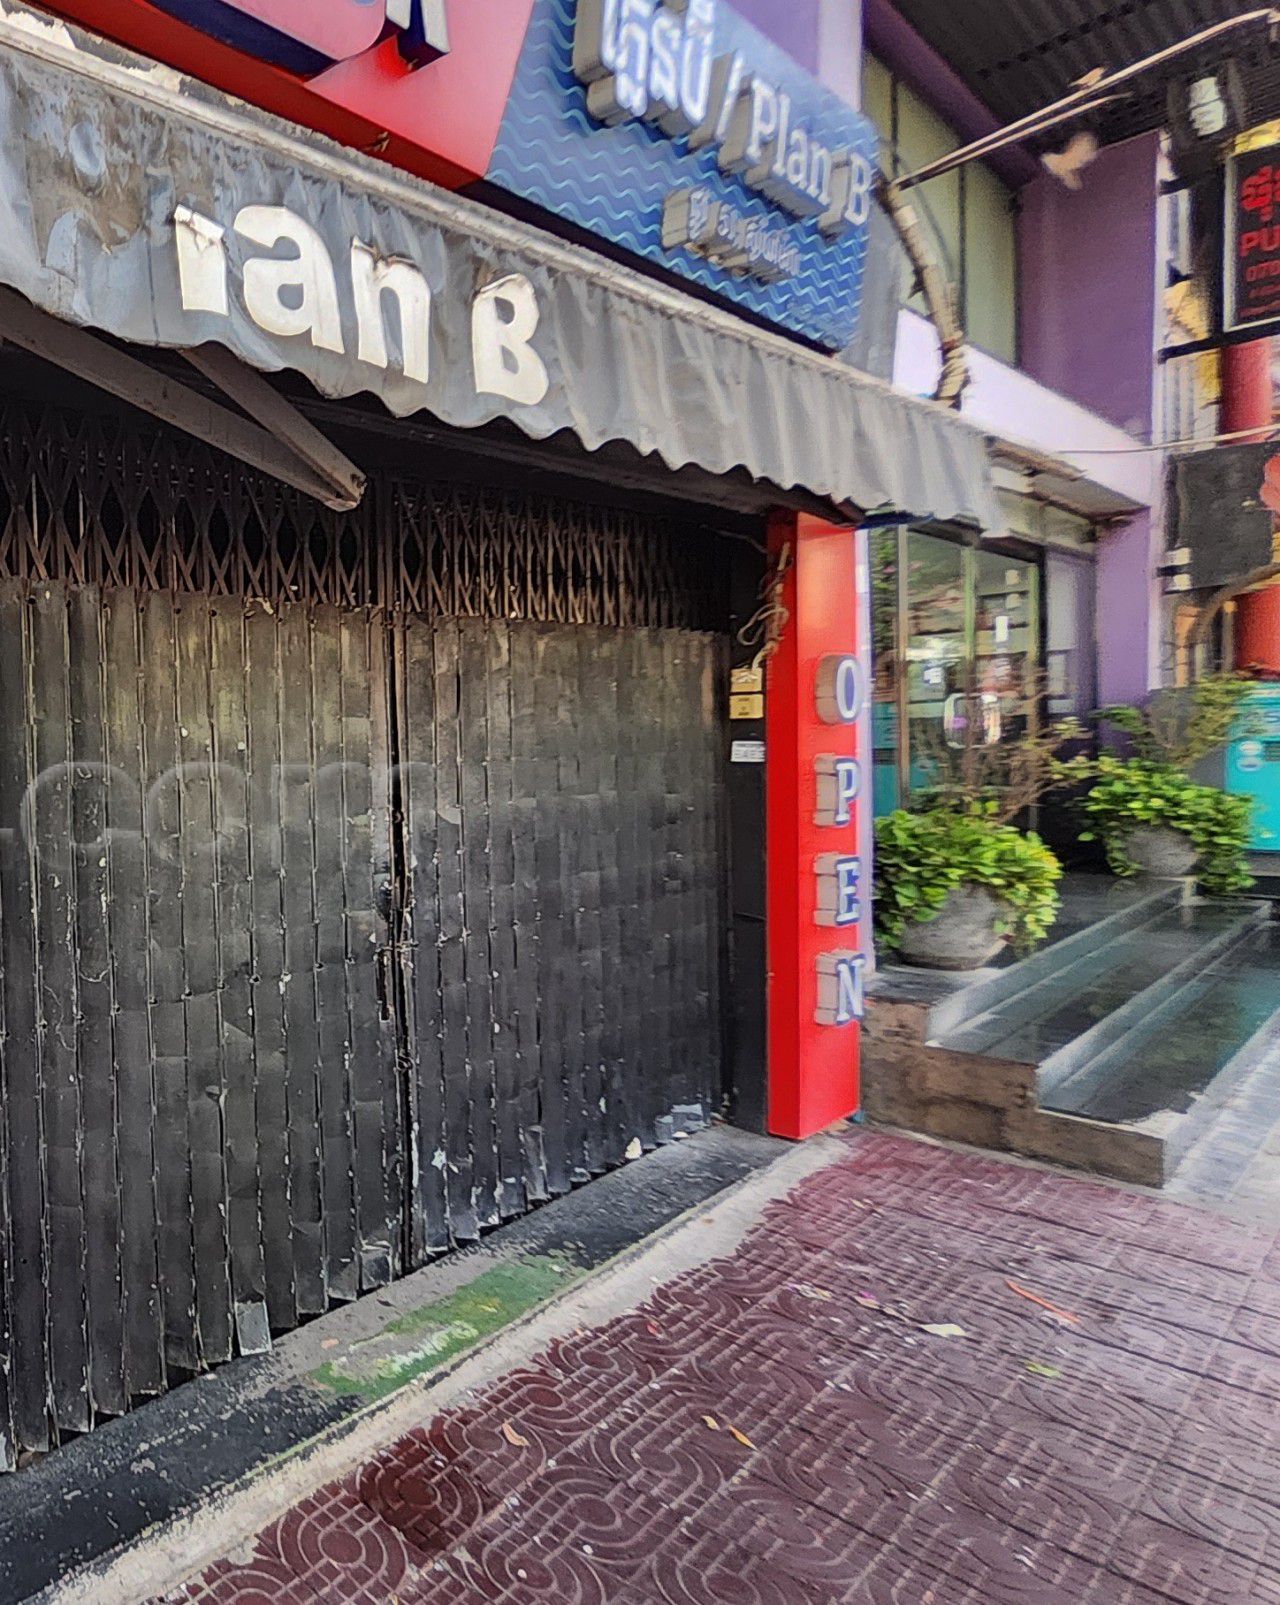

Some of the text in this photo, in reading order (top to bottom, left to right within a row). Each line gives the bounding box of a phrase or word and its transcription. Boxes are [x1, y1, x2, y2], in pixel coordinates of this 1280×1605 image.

[746, 77, 834, 208] Plan
[843, 150, 872, 227] B
[471, 272, 550, 406] B
[821, 653, 867, 1027] OPEN
